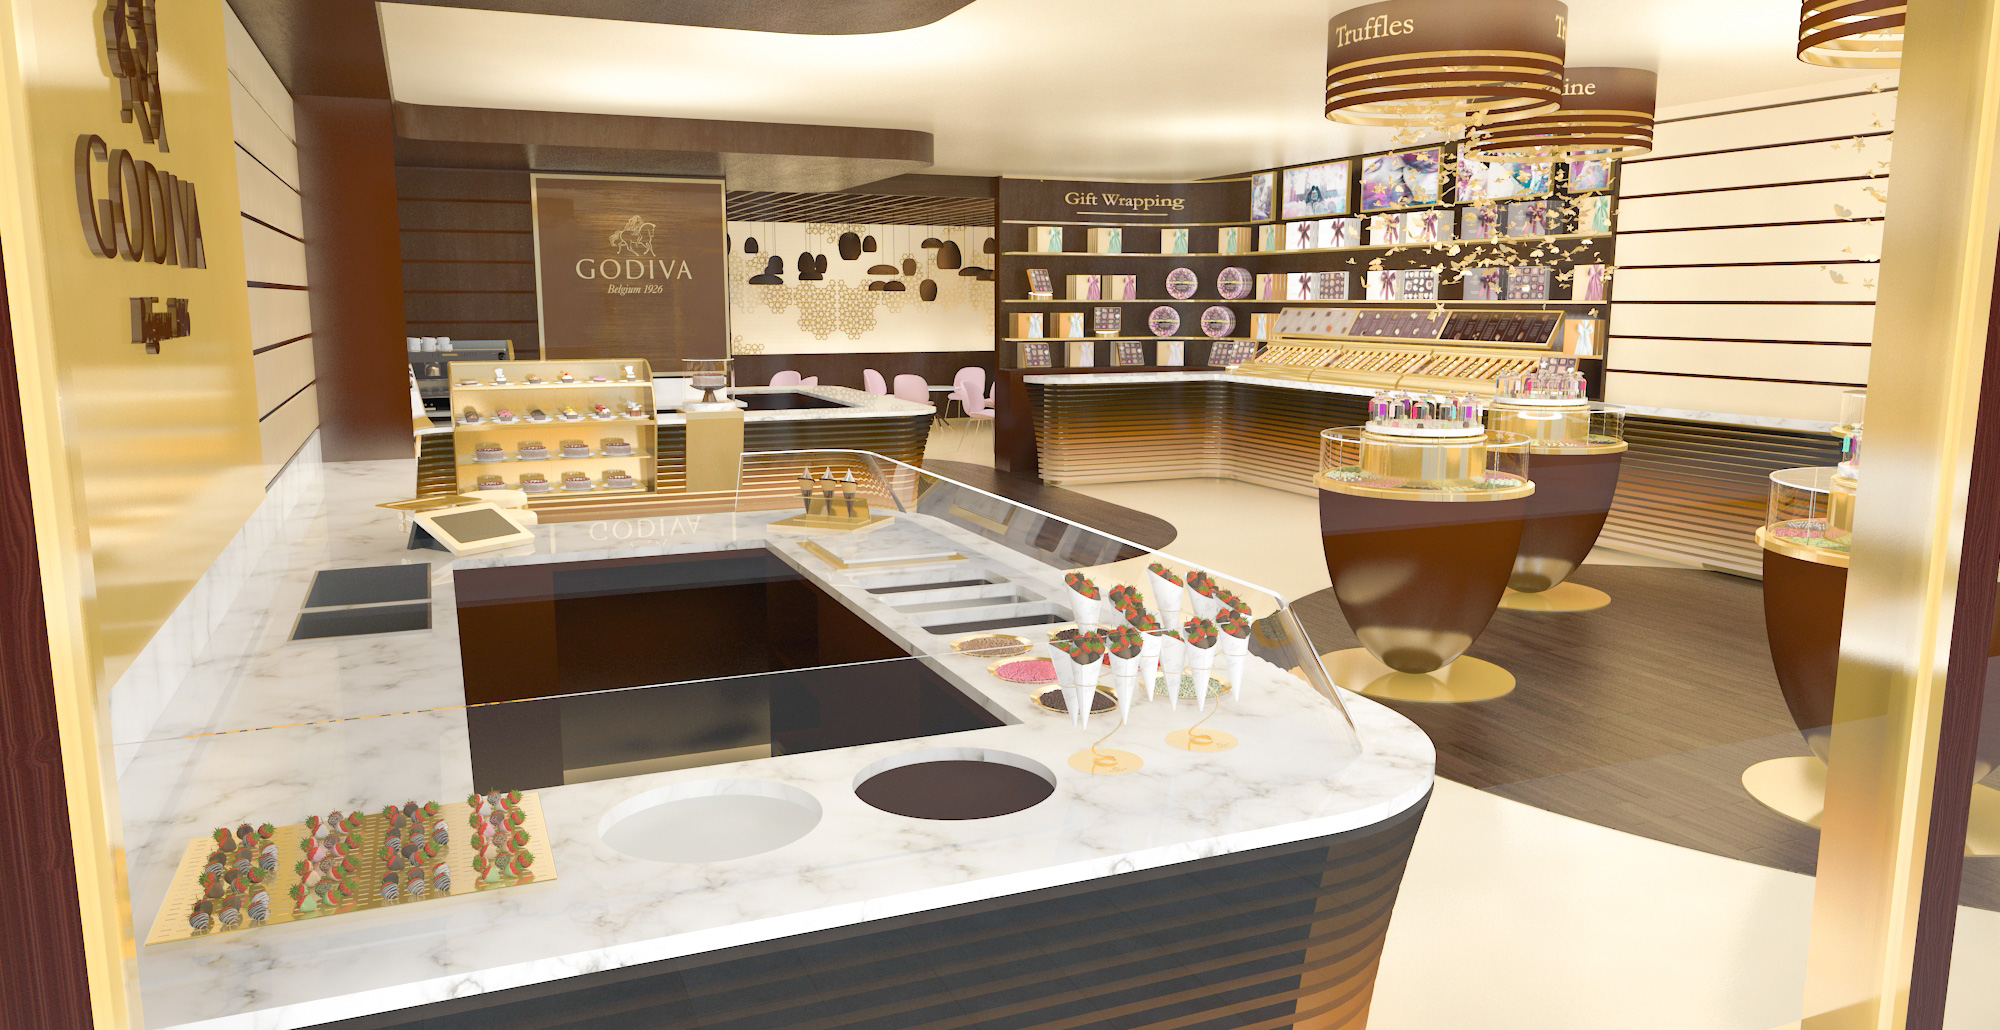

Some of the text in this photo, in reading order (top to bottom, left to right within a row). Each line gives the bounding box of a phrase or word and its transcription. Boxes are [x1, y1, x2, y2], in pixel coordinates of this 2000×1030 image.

[1335, 14, 1414, 48] Truffles
[75, 134, 207, 270] GODIVA
[1064, 191, 1186, 211] Gift Wrapping
[575, 258, 693, 280] GODIVA
[607, 284, 663, 296] Belgium 1926
